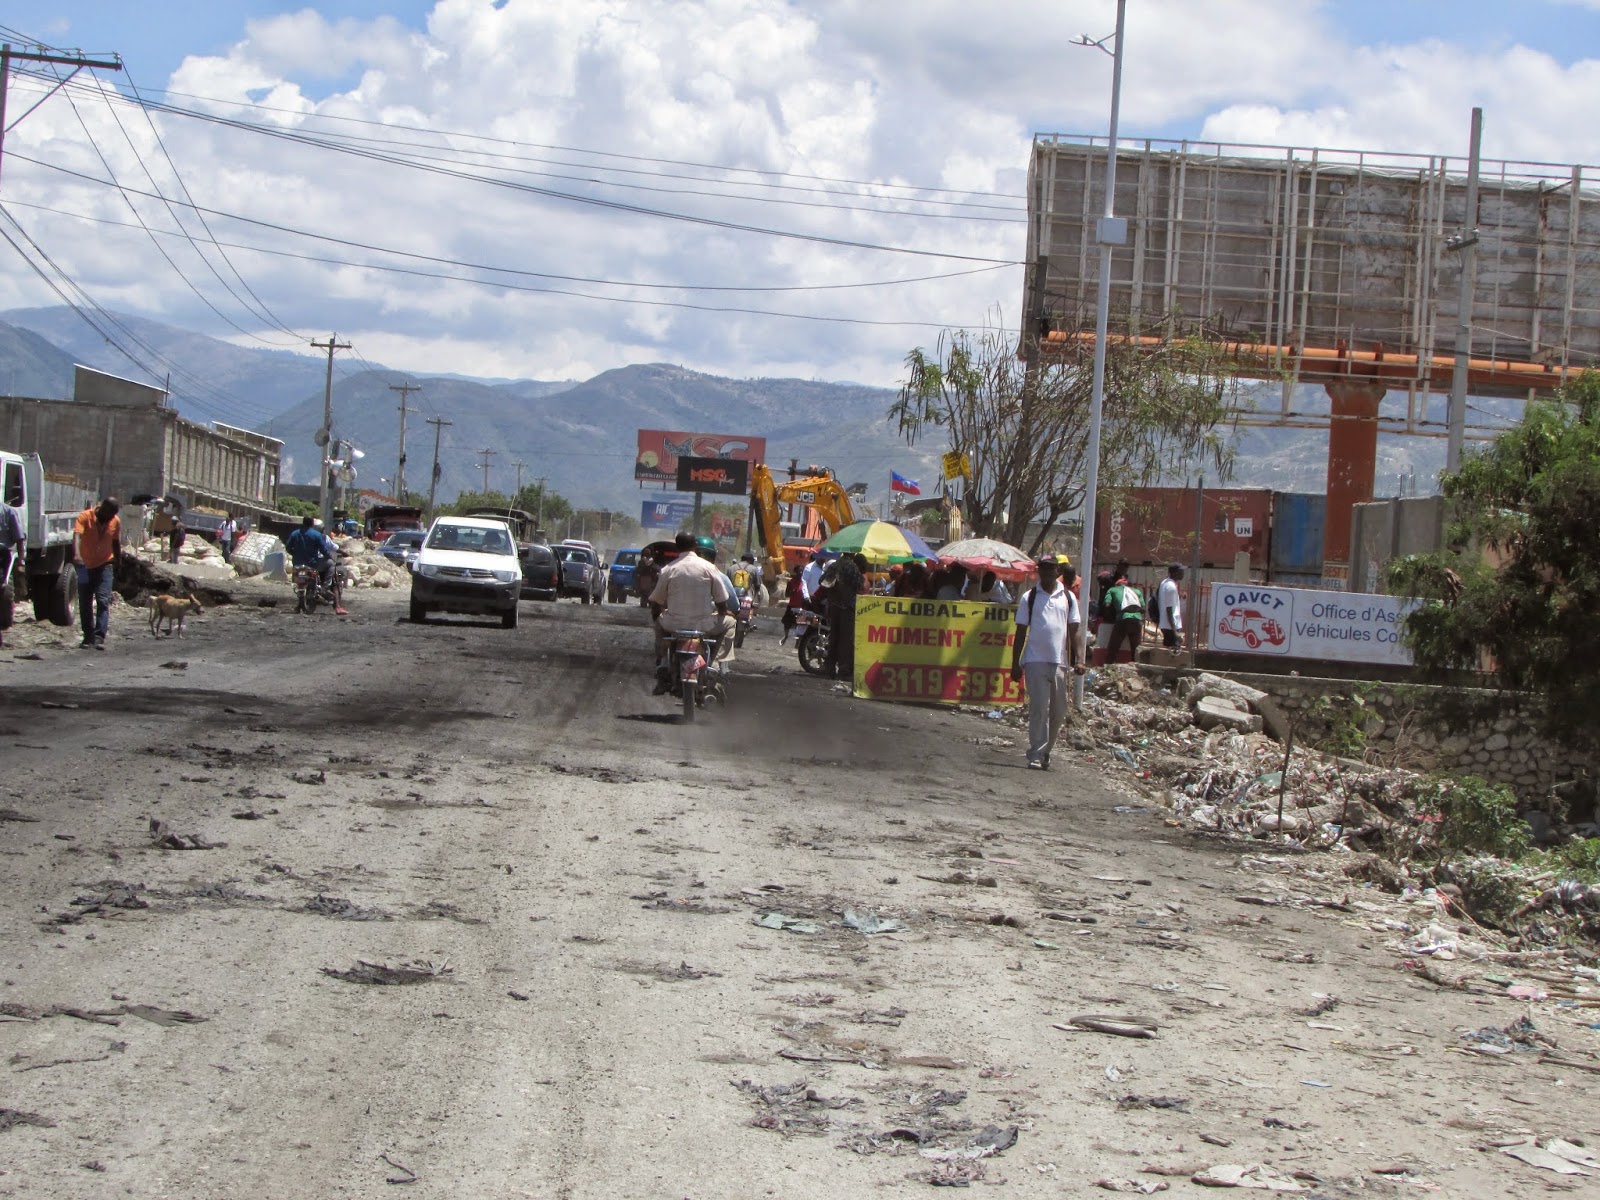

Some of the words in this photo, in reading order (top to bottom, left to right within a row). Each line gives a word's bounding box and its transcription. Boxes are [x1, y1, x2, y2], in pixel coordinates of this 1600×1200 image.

[690, 468, 727, 482] MSC
[796, 491, 815, 503] JCB
[1236, 527, 1251, 535] UN
[856, 600, 882, 616] SPECIAL
[884, 600, 966, 618] GLOBAL
[1224, 591, 1284, 610] OAVCT
[1311, 603, 1357, 620] Office
[867, 624, 966, 648] MOMENT
[1295, 622, 1371, 641] Véhicules
[881, 666, 943, 696] 3119
